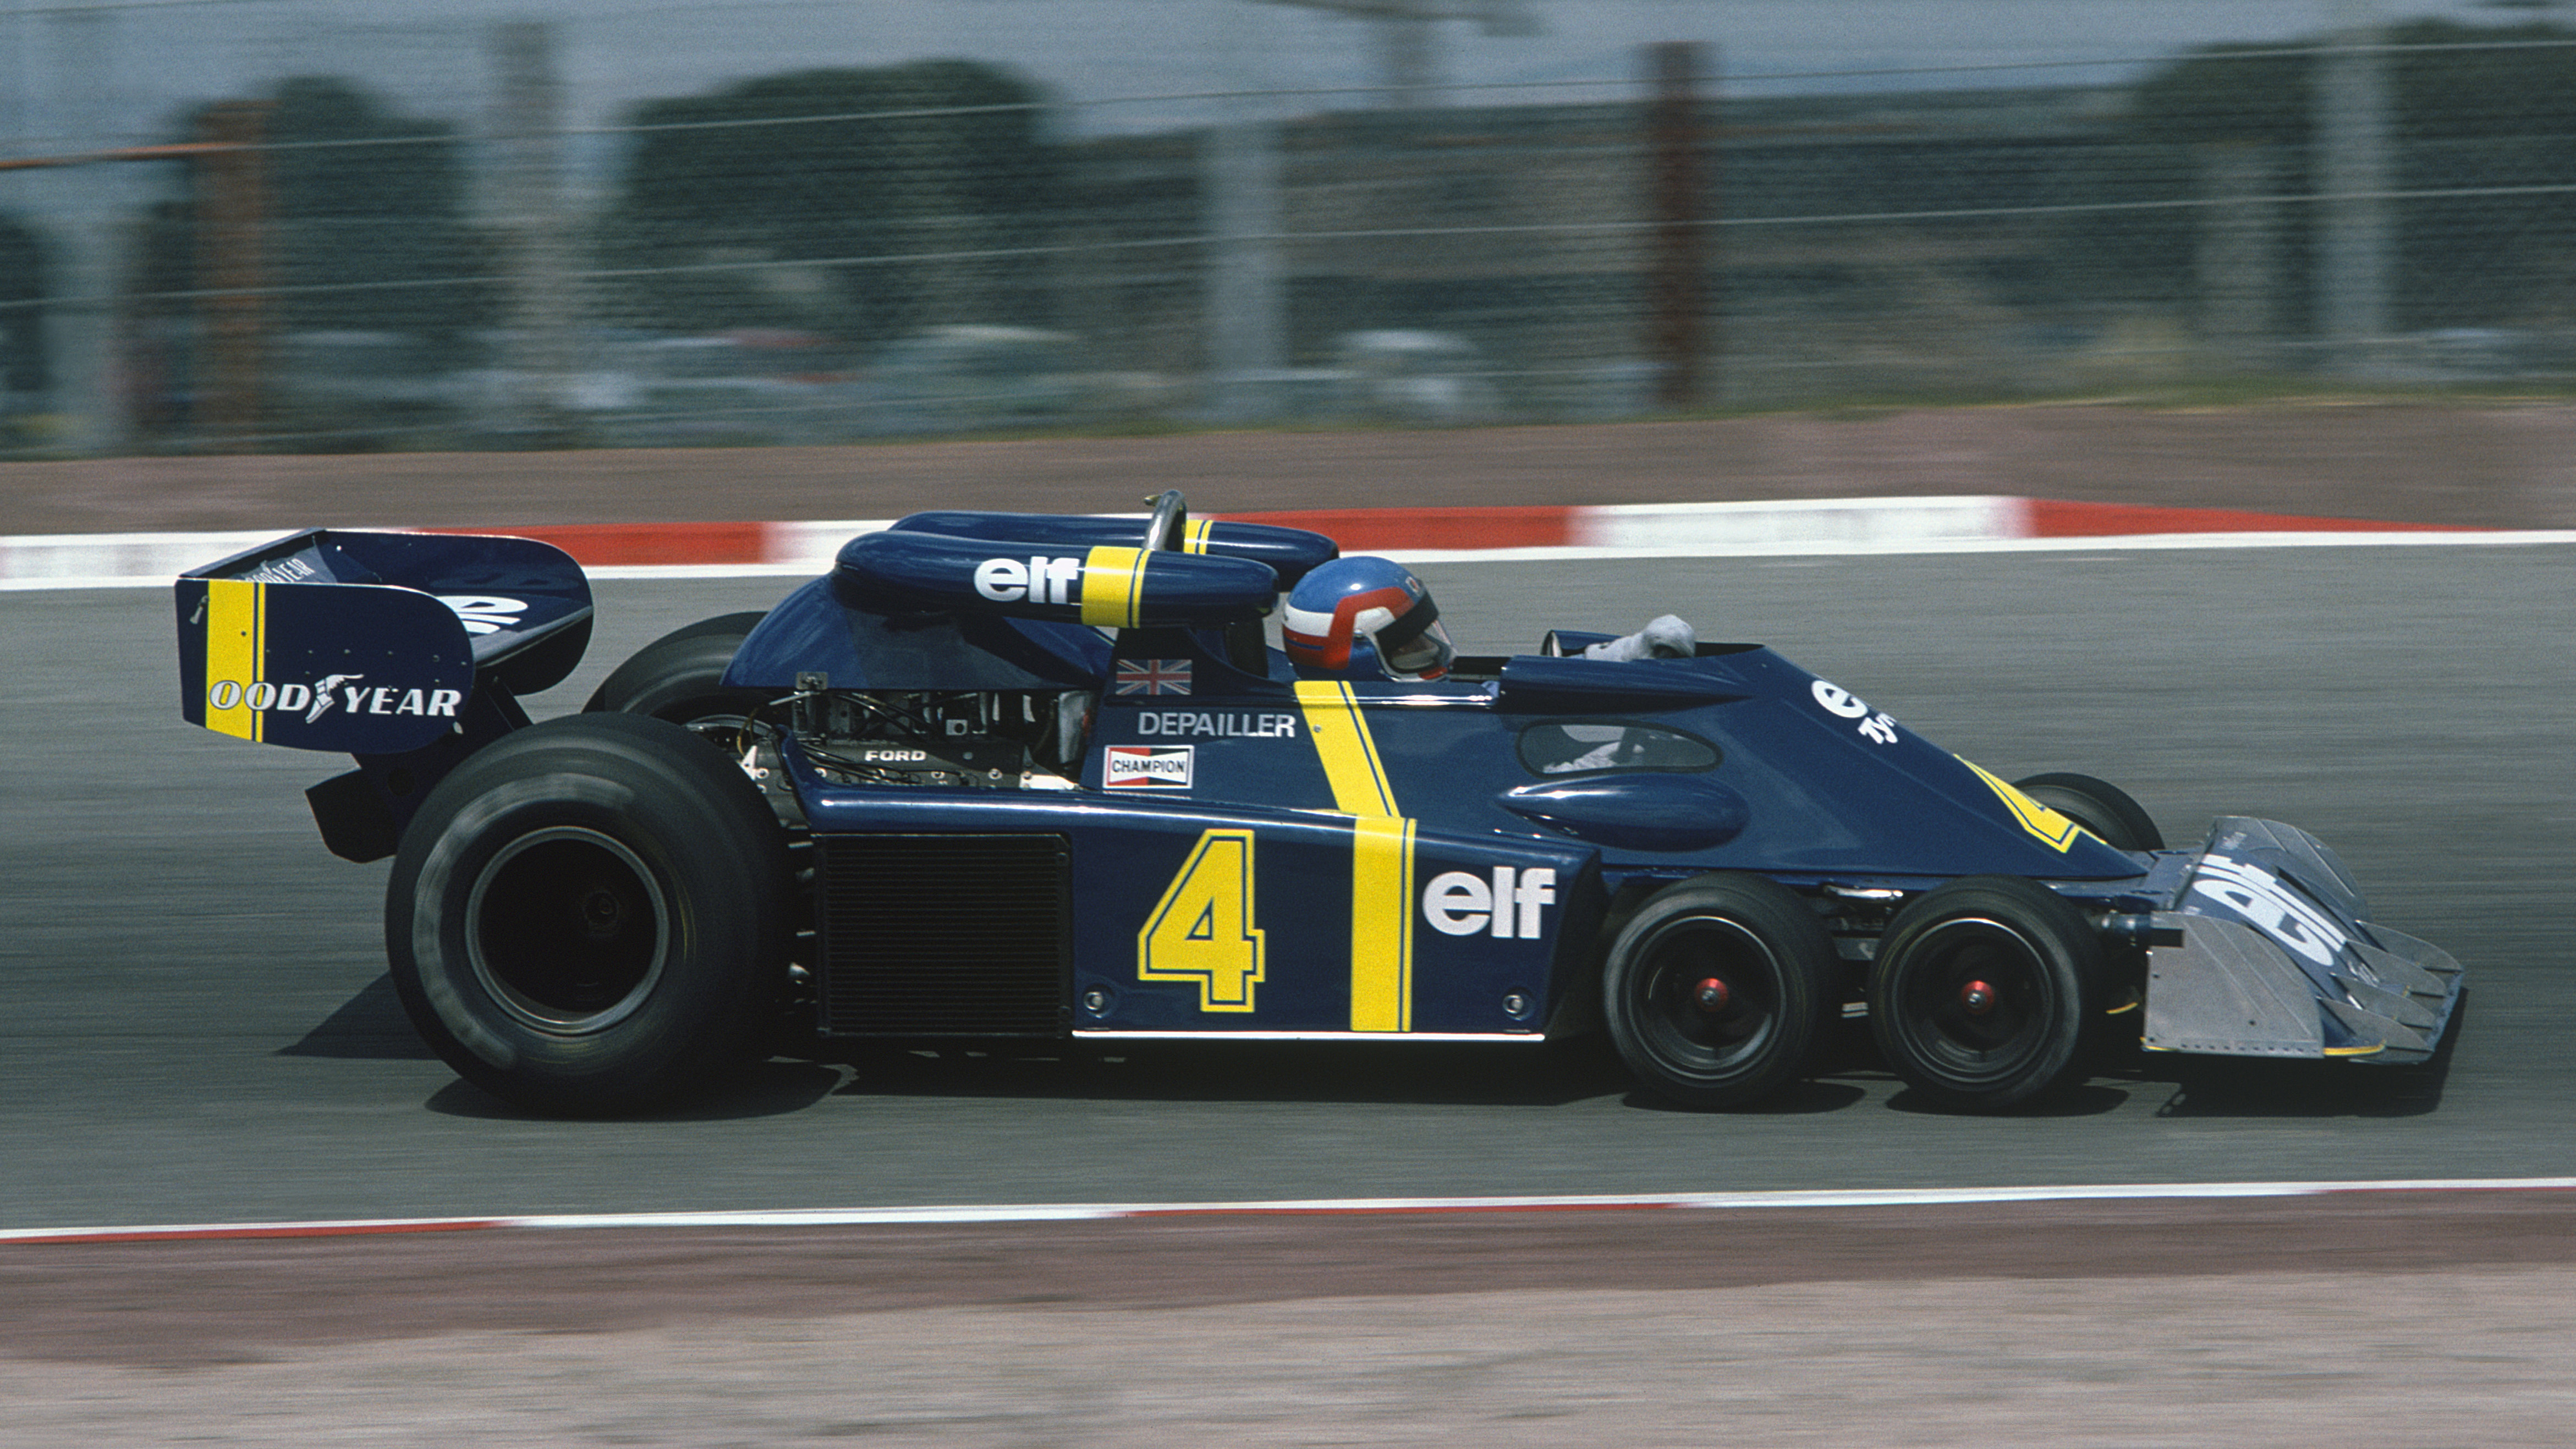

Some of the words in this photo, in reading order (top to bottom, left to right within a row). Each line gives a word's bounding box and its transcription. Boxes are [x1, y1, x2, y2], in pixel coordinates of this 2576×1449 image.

[974, 556, 1079, 604] elf
[1138, 712, 1295, 738] DEPAILLER
[865, 750, 926, 761] FORD
[1112, 760, 1185, 773] CHAMPION
[1138, 829, 1265, 1012] 4
[1422, 866, 1556, 938] elf
[2193, 854, 2347, 965] elf
